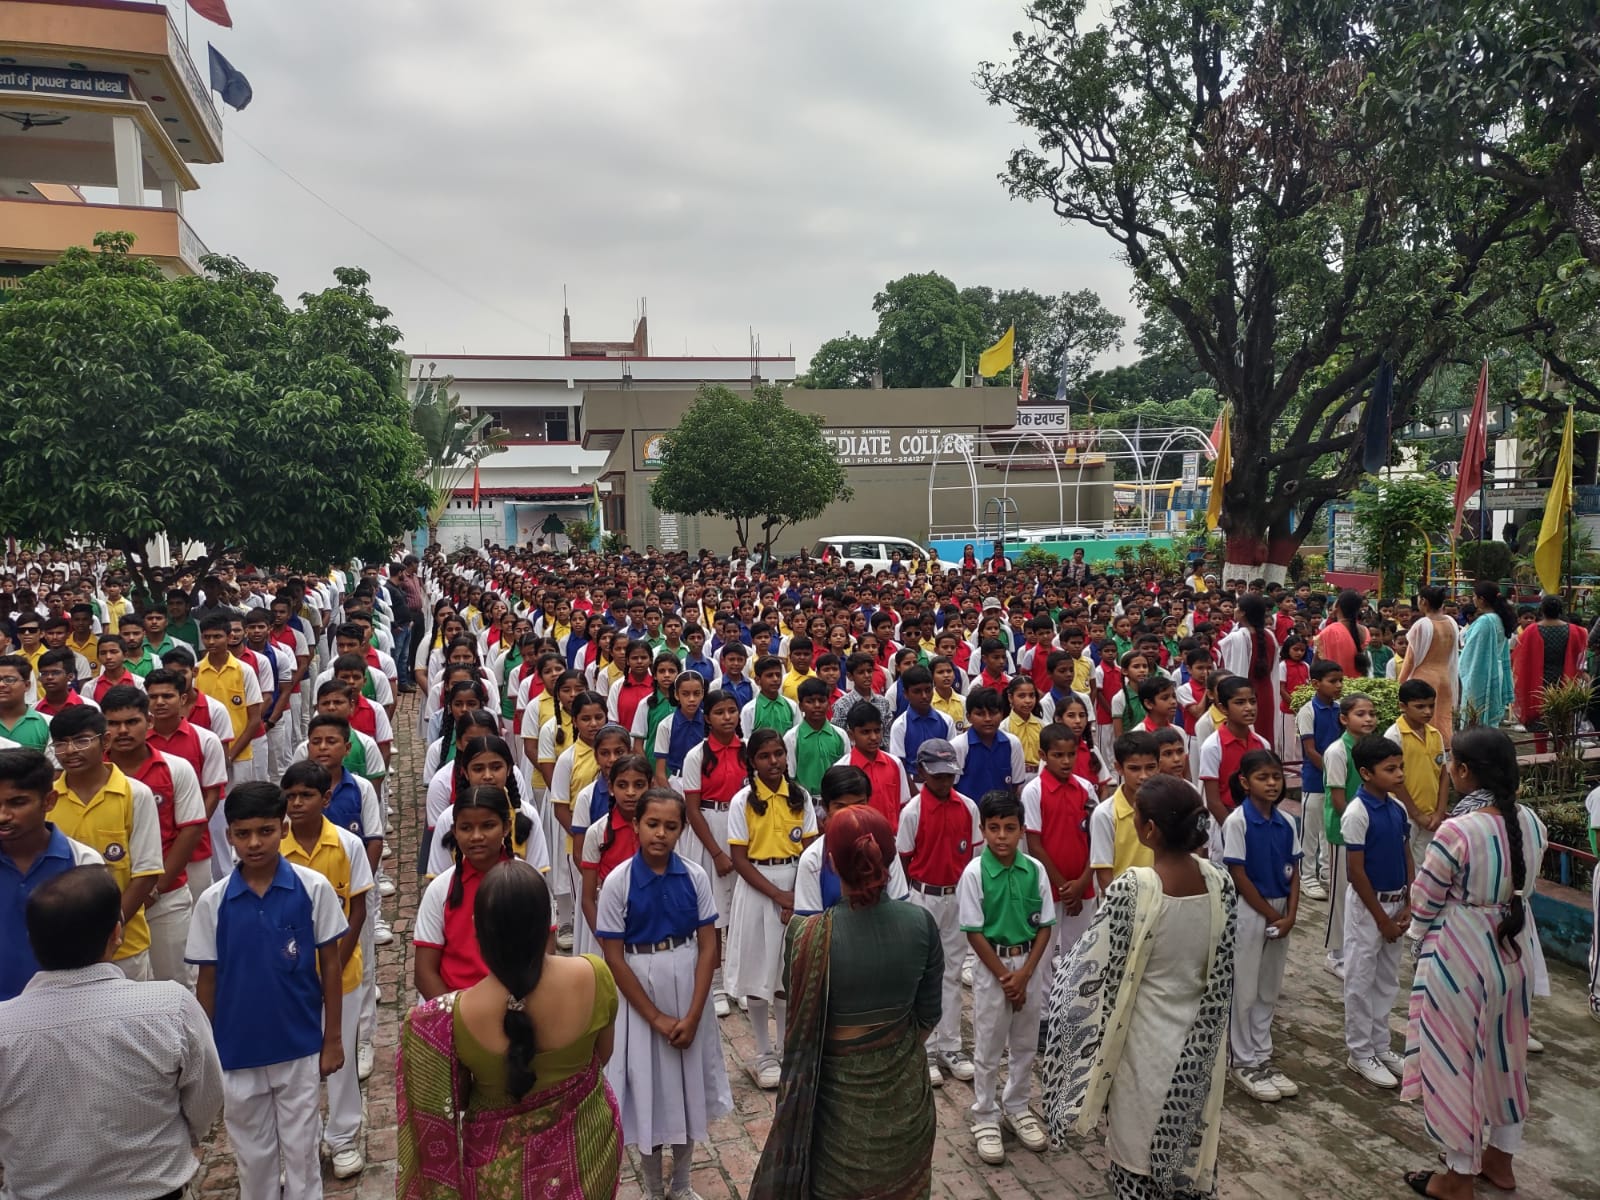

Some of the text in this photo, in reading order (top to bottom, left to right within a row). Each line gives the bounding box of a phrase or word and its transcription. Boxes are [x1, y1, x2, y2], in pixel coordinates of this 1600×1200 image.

[17, 73, 31, 86] of
[32, 76, 68, 91] power
[70, 78, 92, 91] and
[900, 435, 975, 455] COLLEGE
